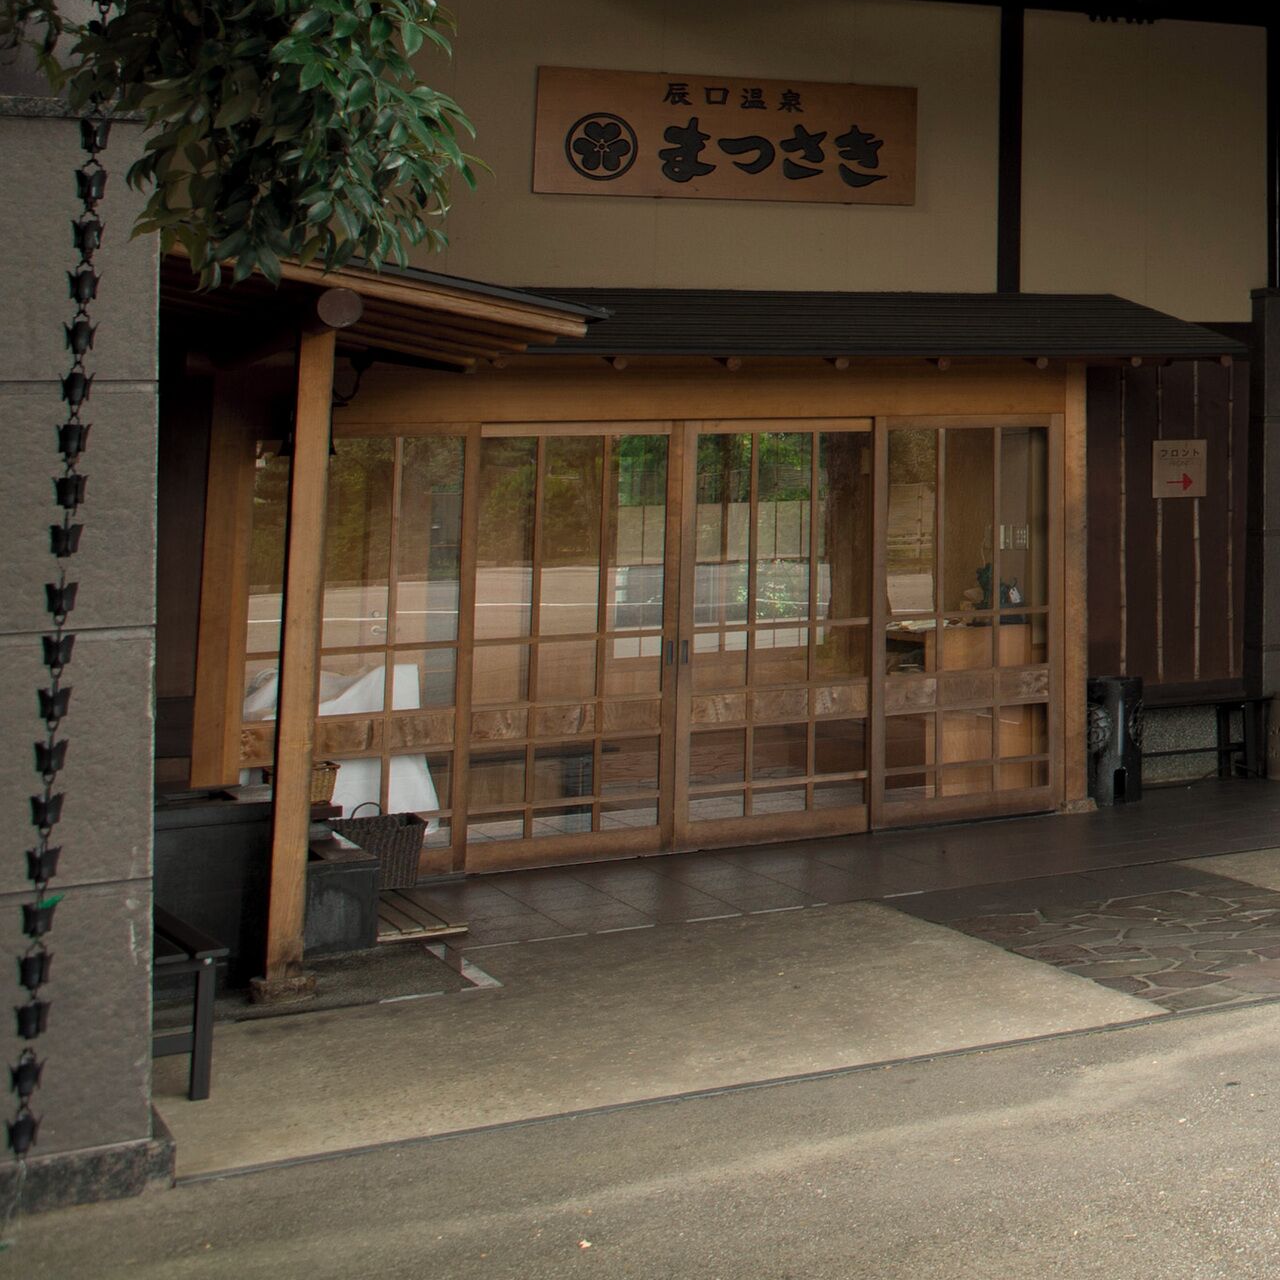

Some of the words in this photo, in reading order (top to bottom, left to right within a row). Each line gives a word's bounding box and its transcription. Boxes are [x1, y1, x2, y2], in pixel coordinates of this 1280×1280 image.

[662, 82, 804, 113] 辰口温泉
[658, 116, 889, 188] まつさき
[1159, 448, 1200, 458] フロント
